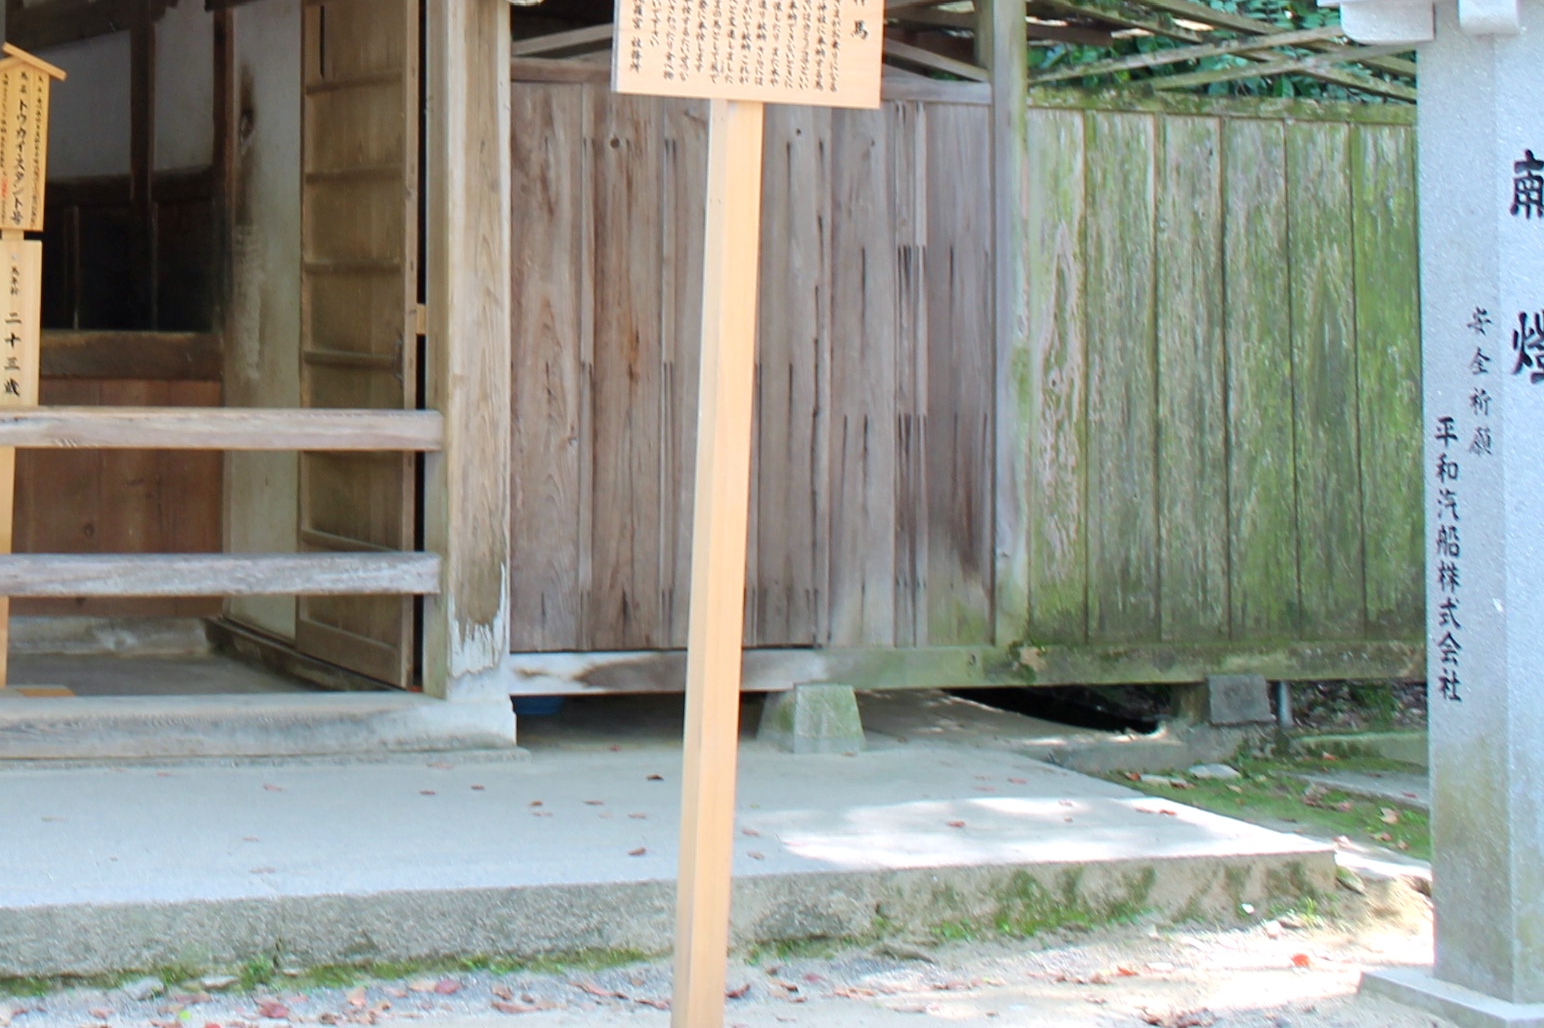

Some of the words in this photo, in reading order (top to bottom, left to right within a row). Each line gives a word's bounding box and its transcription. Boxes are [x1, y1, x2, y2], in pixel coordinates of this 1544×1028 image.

[1466, 306, 1493, 456] 安全祈願
[1435, 416, 1462, 703] 平和汽船株式会社
